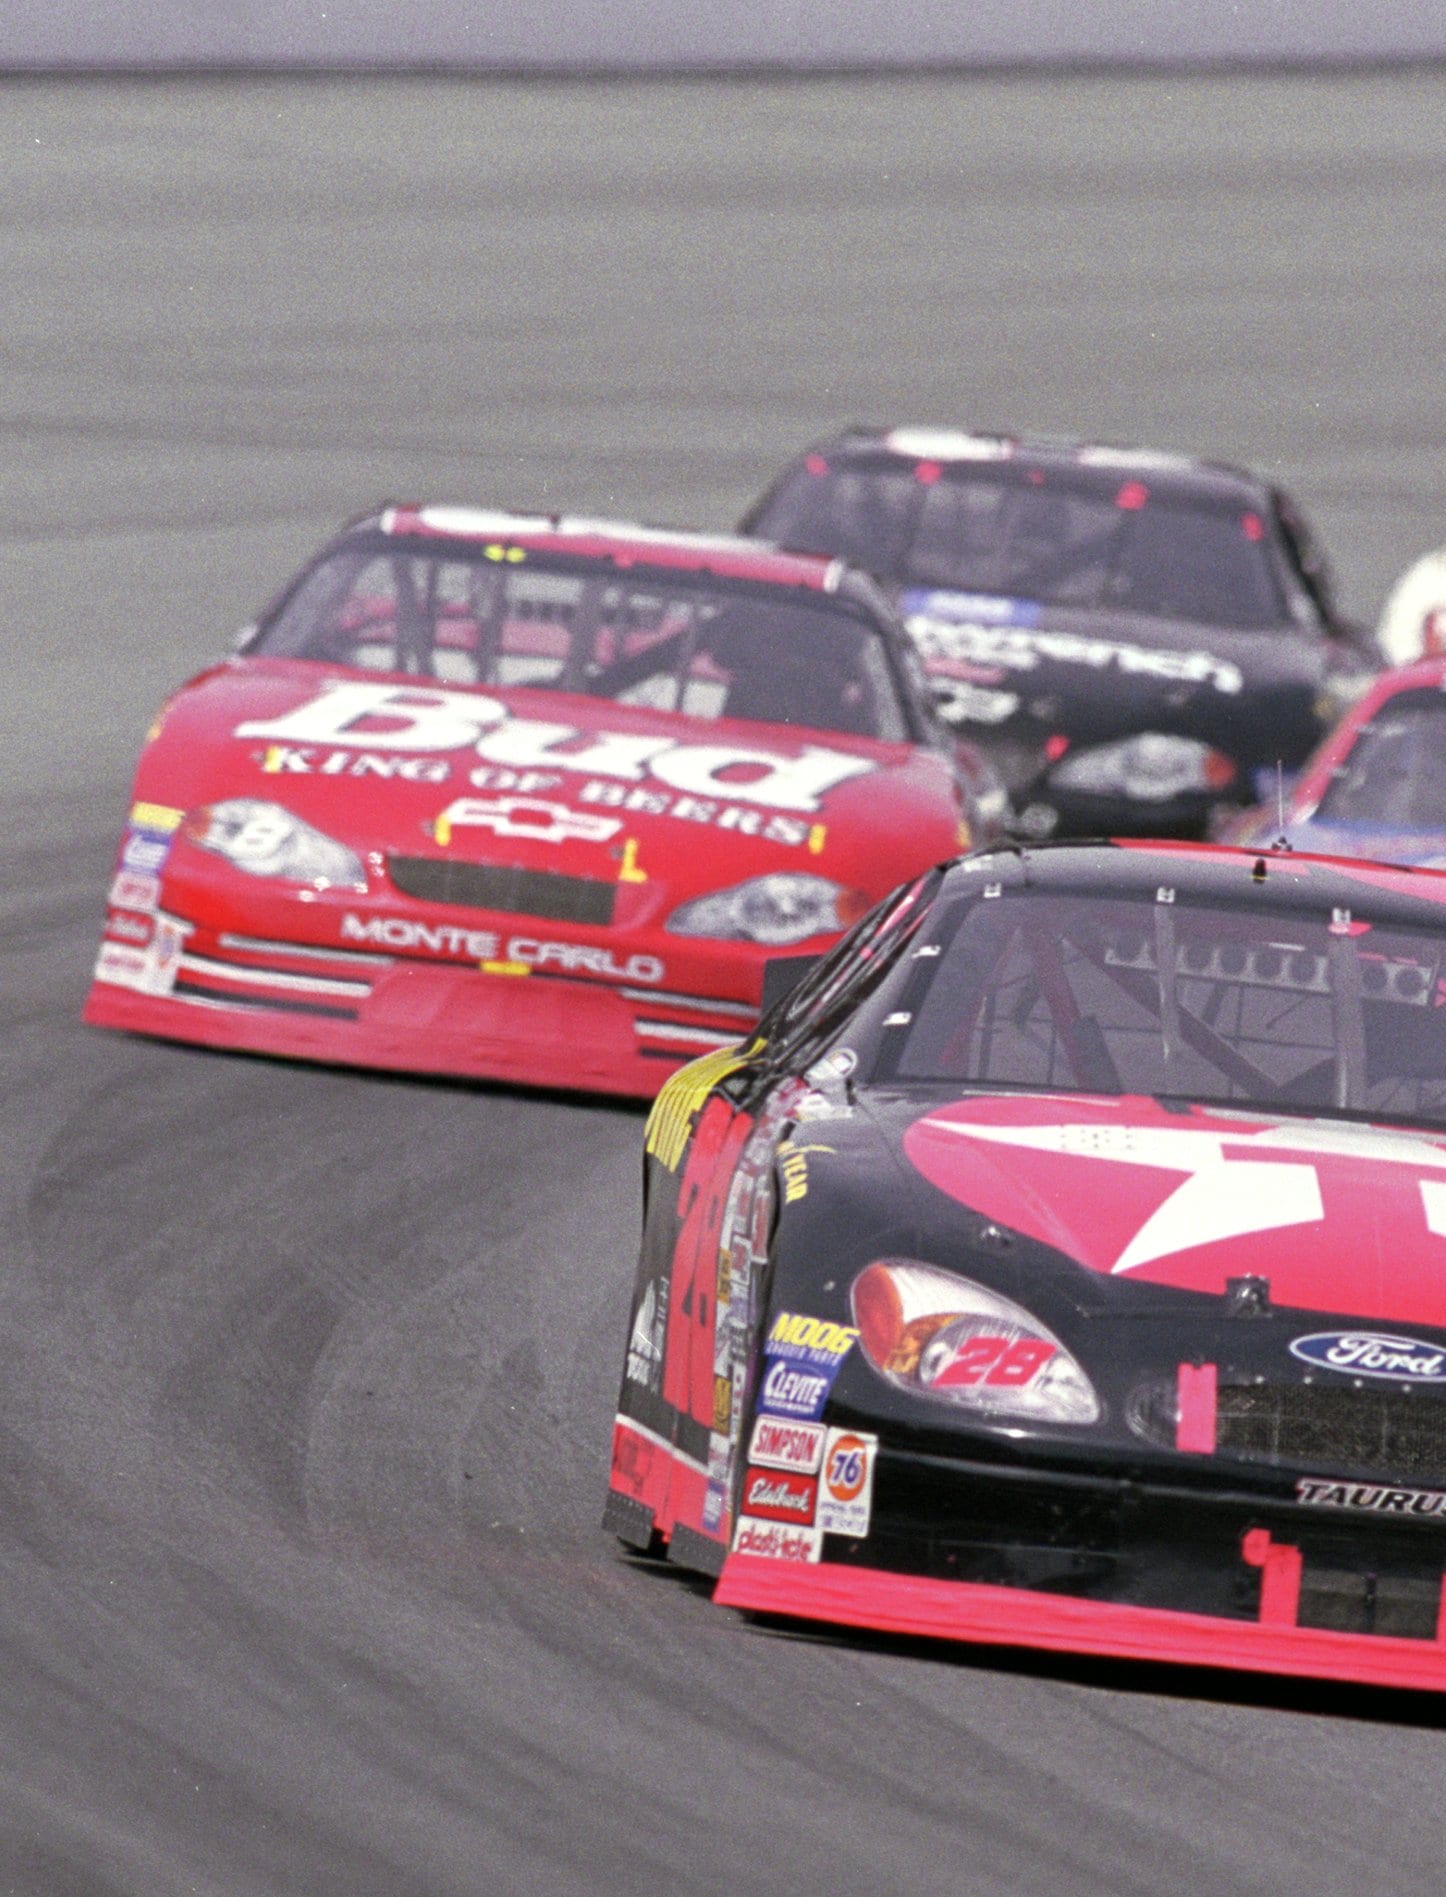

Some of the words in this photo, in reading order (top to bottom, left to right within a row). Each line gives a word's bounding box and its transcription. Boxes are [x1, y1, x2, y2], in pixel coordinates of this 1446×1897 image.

[234, 677, 877, 812] Bud
[262, 745, 451, 783] KING
[469, 768, 562, 793] OF
[578, 780, 808, 846] BEERS
[340, 903, 500, 957] MONTE
[507, 936, 665, 982] CARLO
[769, 1312, 861, 1355] MOOG
[1326, 1336, 1443, 1375] Ford
[930, 1334, 1057, 1389] 28
[755, 1424, 819, 1463] SIMPSON
[829, 1450, 863, 1485] 76
